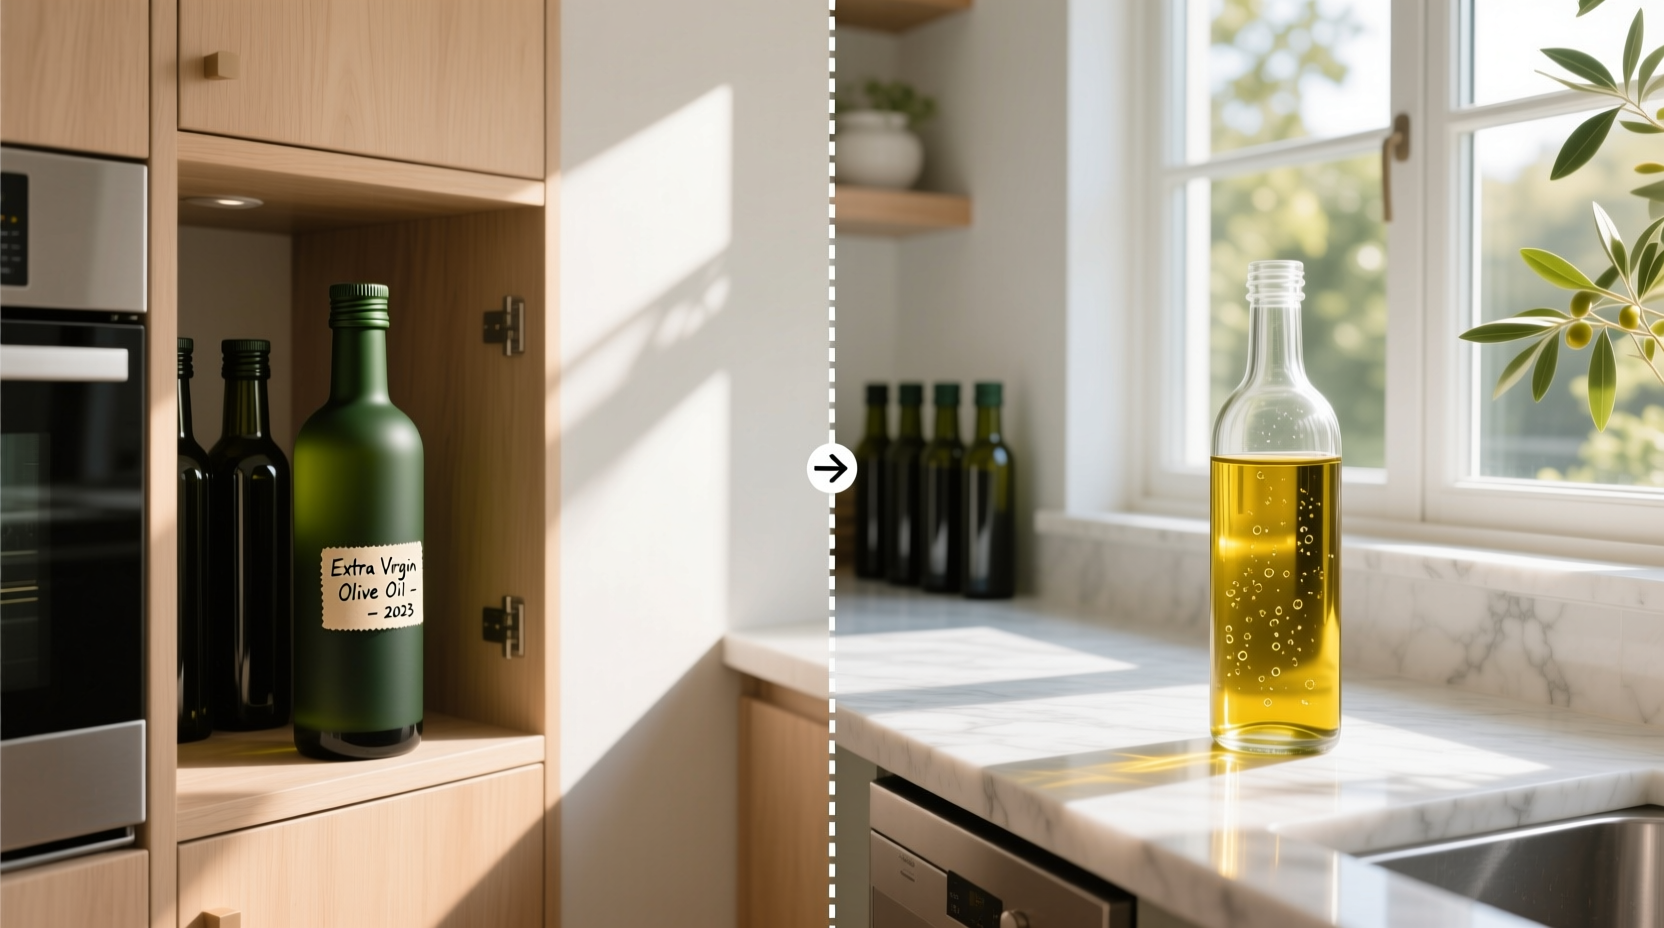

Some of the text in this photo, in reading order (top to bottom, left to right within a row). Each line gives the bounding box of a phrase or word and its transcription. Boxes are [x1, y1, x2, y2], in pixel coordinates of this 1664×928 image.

[331, 558, 375, 577] Extra
[338, 582, 379, 602] Olive
[385, 581, 405, 598] Oil
[383, 603, 414, 619] 2023
